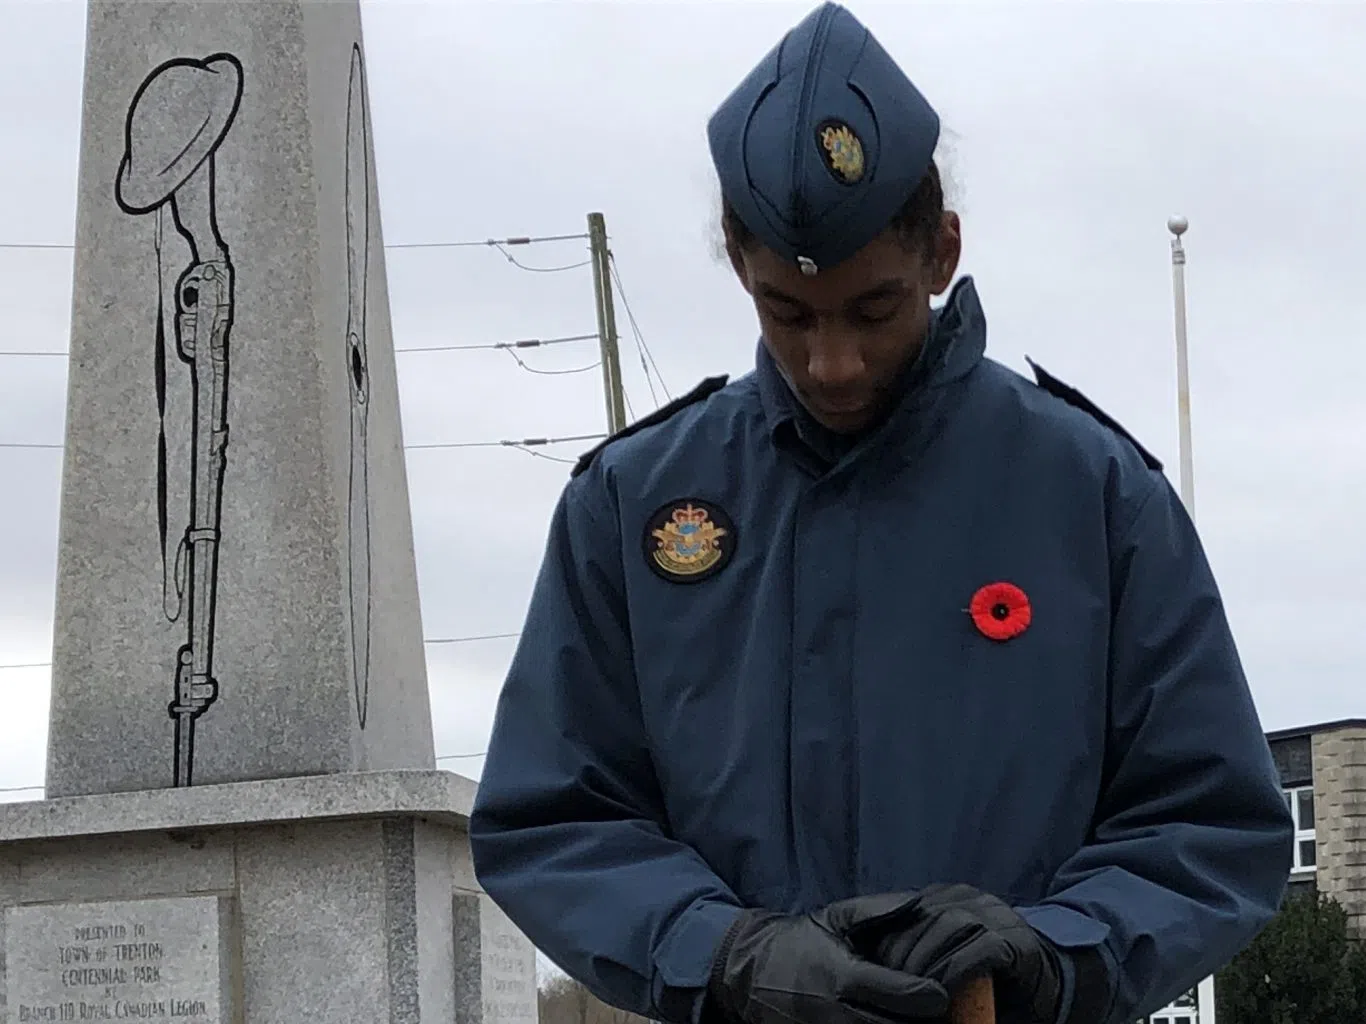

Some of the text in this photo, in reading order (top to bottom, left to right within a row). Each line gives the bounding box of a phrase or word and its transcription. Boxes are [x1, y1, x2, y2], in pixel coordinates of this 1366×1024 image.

[59, 946, 90, 964] TOWN
[113, 943, 163, 961] TRENTON
[134, 966, 160, 983] PARK
[115, 1000, 165, 1018] CANADIAN
[170, 998, 207, 1016] LEGION
